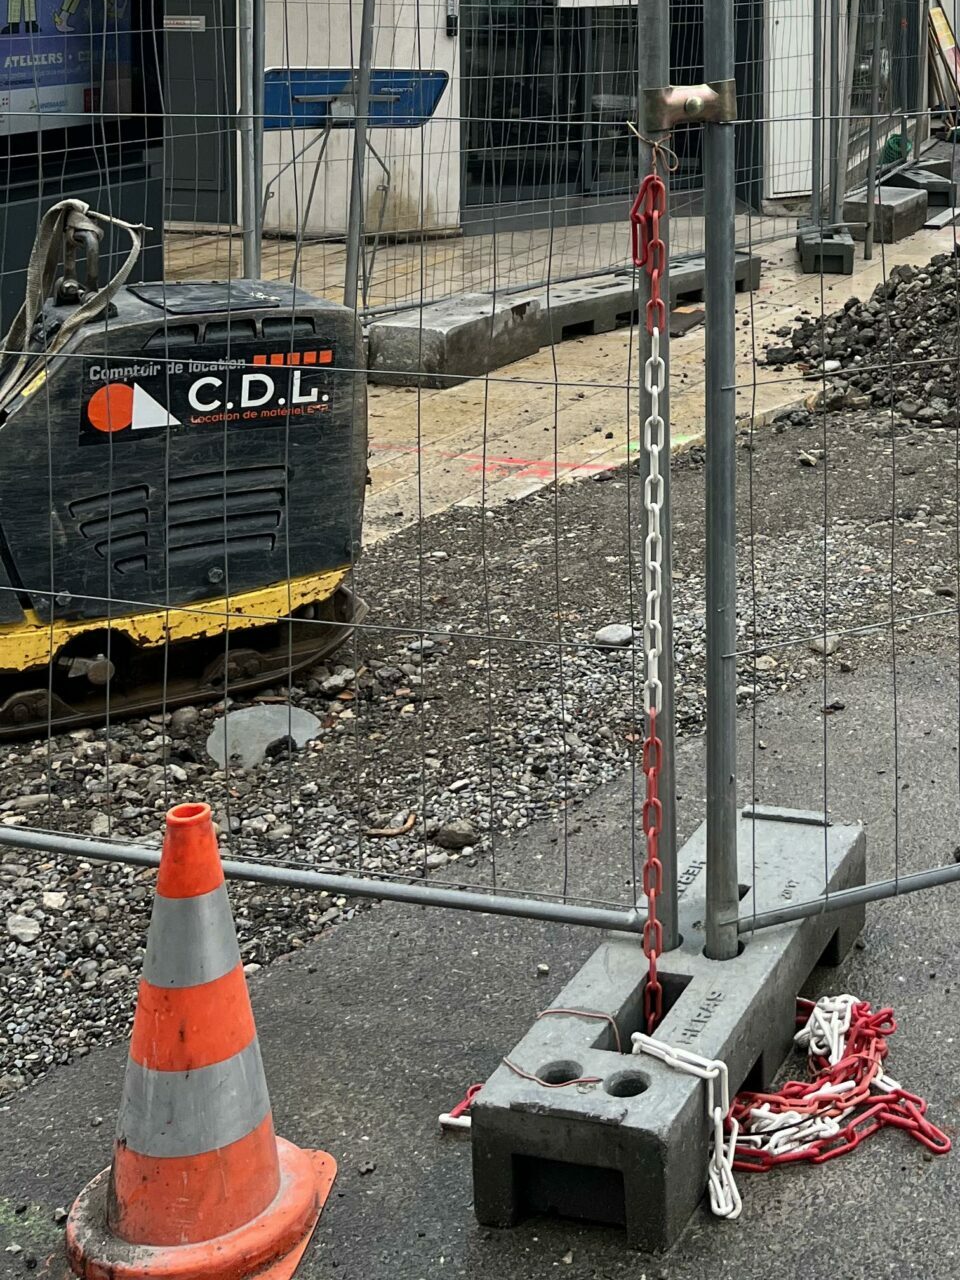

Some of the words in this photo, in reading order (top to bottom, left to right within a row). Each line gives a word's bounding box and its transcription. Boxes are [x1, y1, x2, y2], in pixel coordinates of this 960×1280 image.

[4, 52, 63, 69] ATELIERS
[89, 361, 161, 382] Comptoir
[166, 361, 184, 375] de
[188, 357, 246, 373] location
[188, 370, 329, 412] C.D.L.
[190, 410, 240, 424] Location
[242, 409, 258, 419] de
[260, 405, 304, 418] matériel
